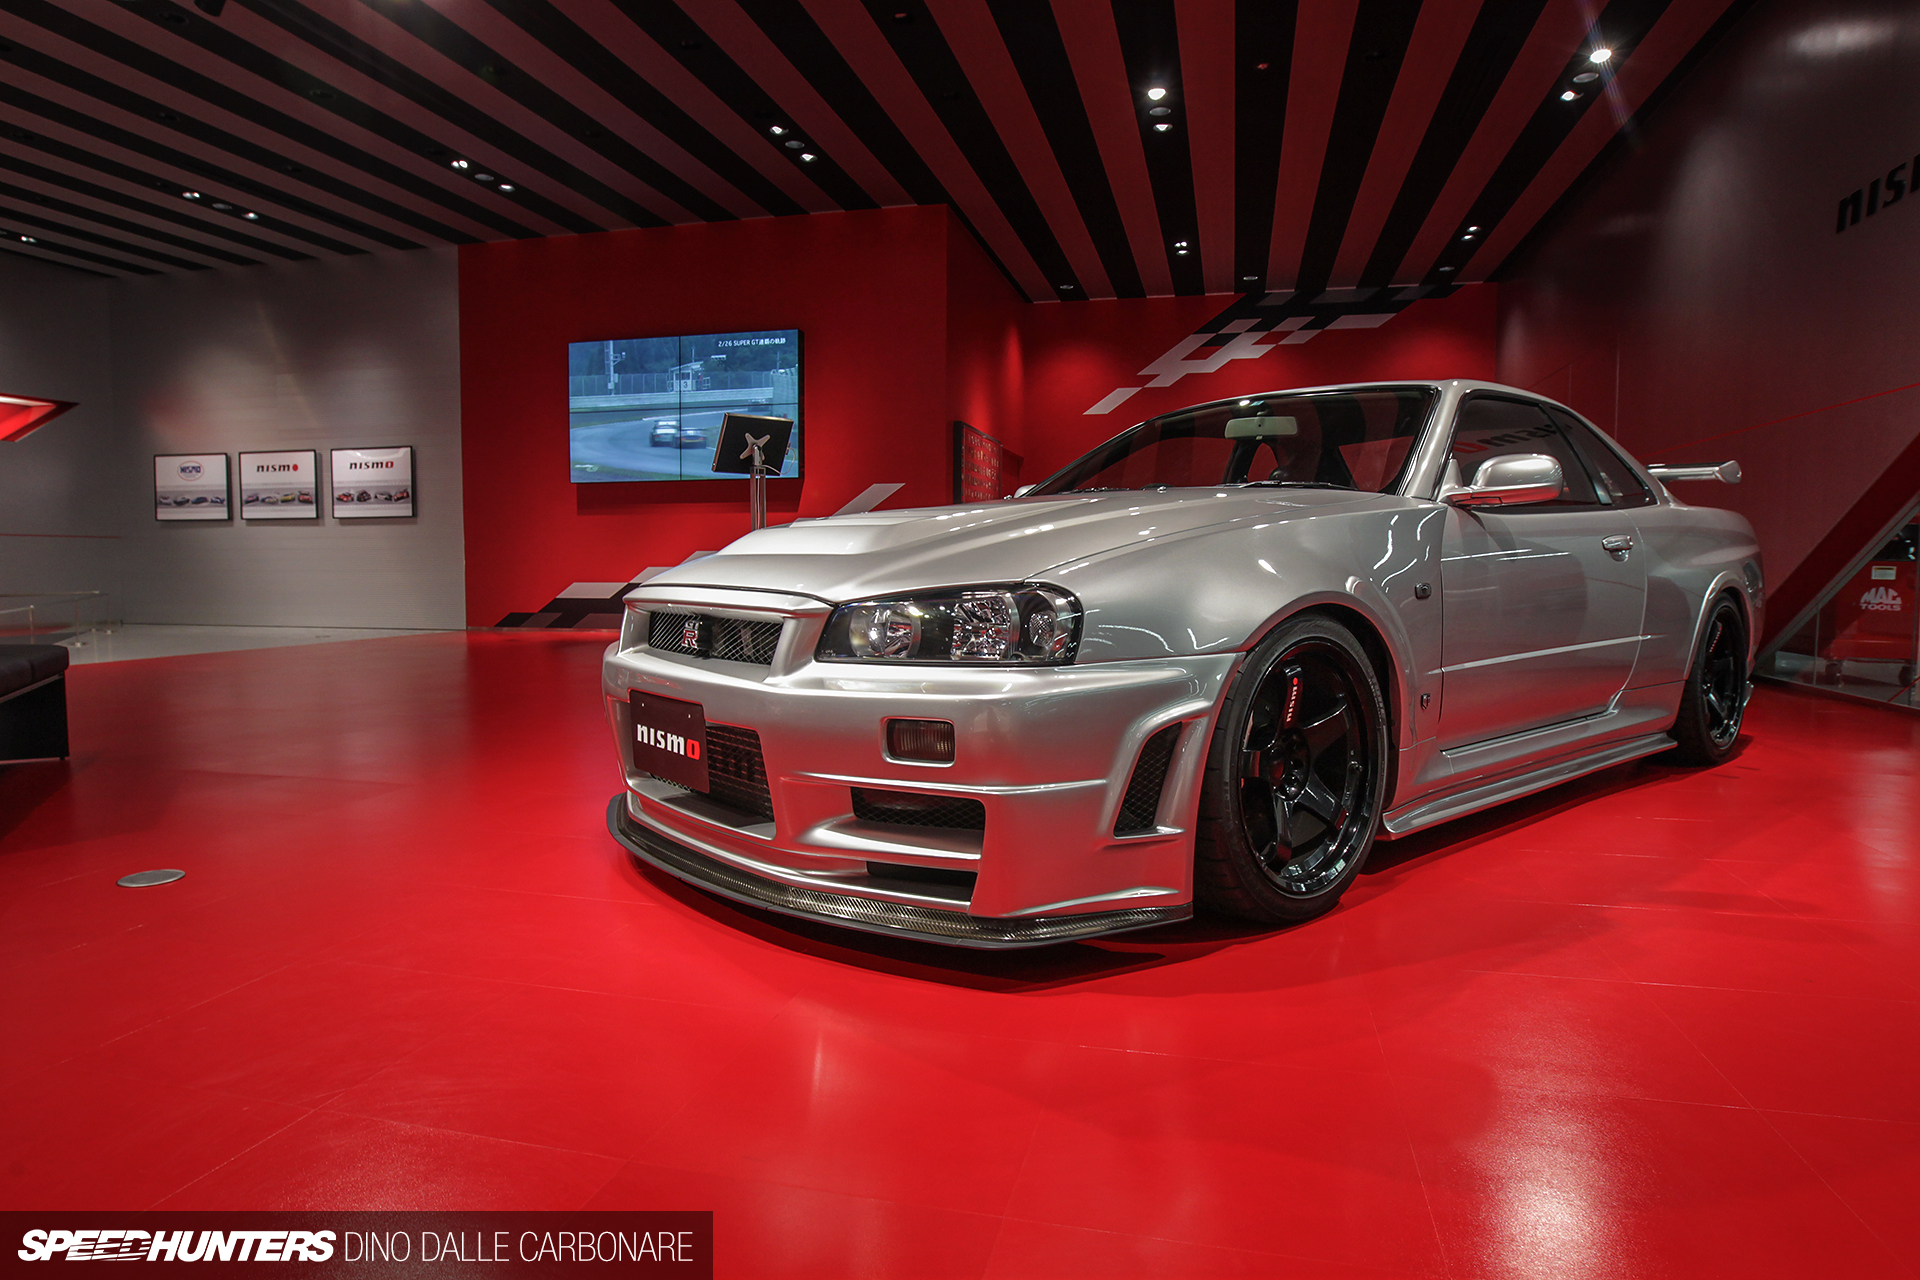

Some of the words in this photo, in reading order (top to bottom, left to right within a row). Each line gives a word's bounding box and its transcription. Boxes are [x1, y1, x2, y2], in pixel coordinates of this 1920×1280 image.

[733, 339, 751, 347] SUPER
[256, 463, 299, 472] nismo
[349, 460, 394, 470] nismo
[1859, 586, 1903, 604] MAC
[1859, 603, 1902, 612] TOOLS
[681, 630, 698, 648] R
[637, 723, 701, 761] nismo
